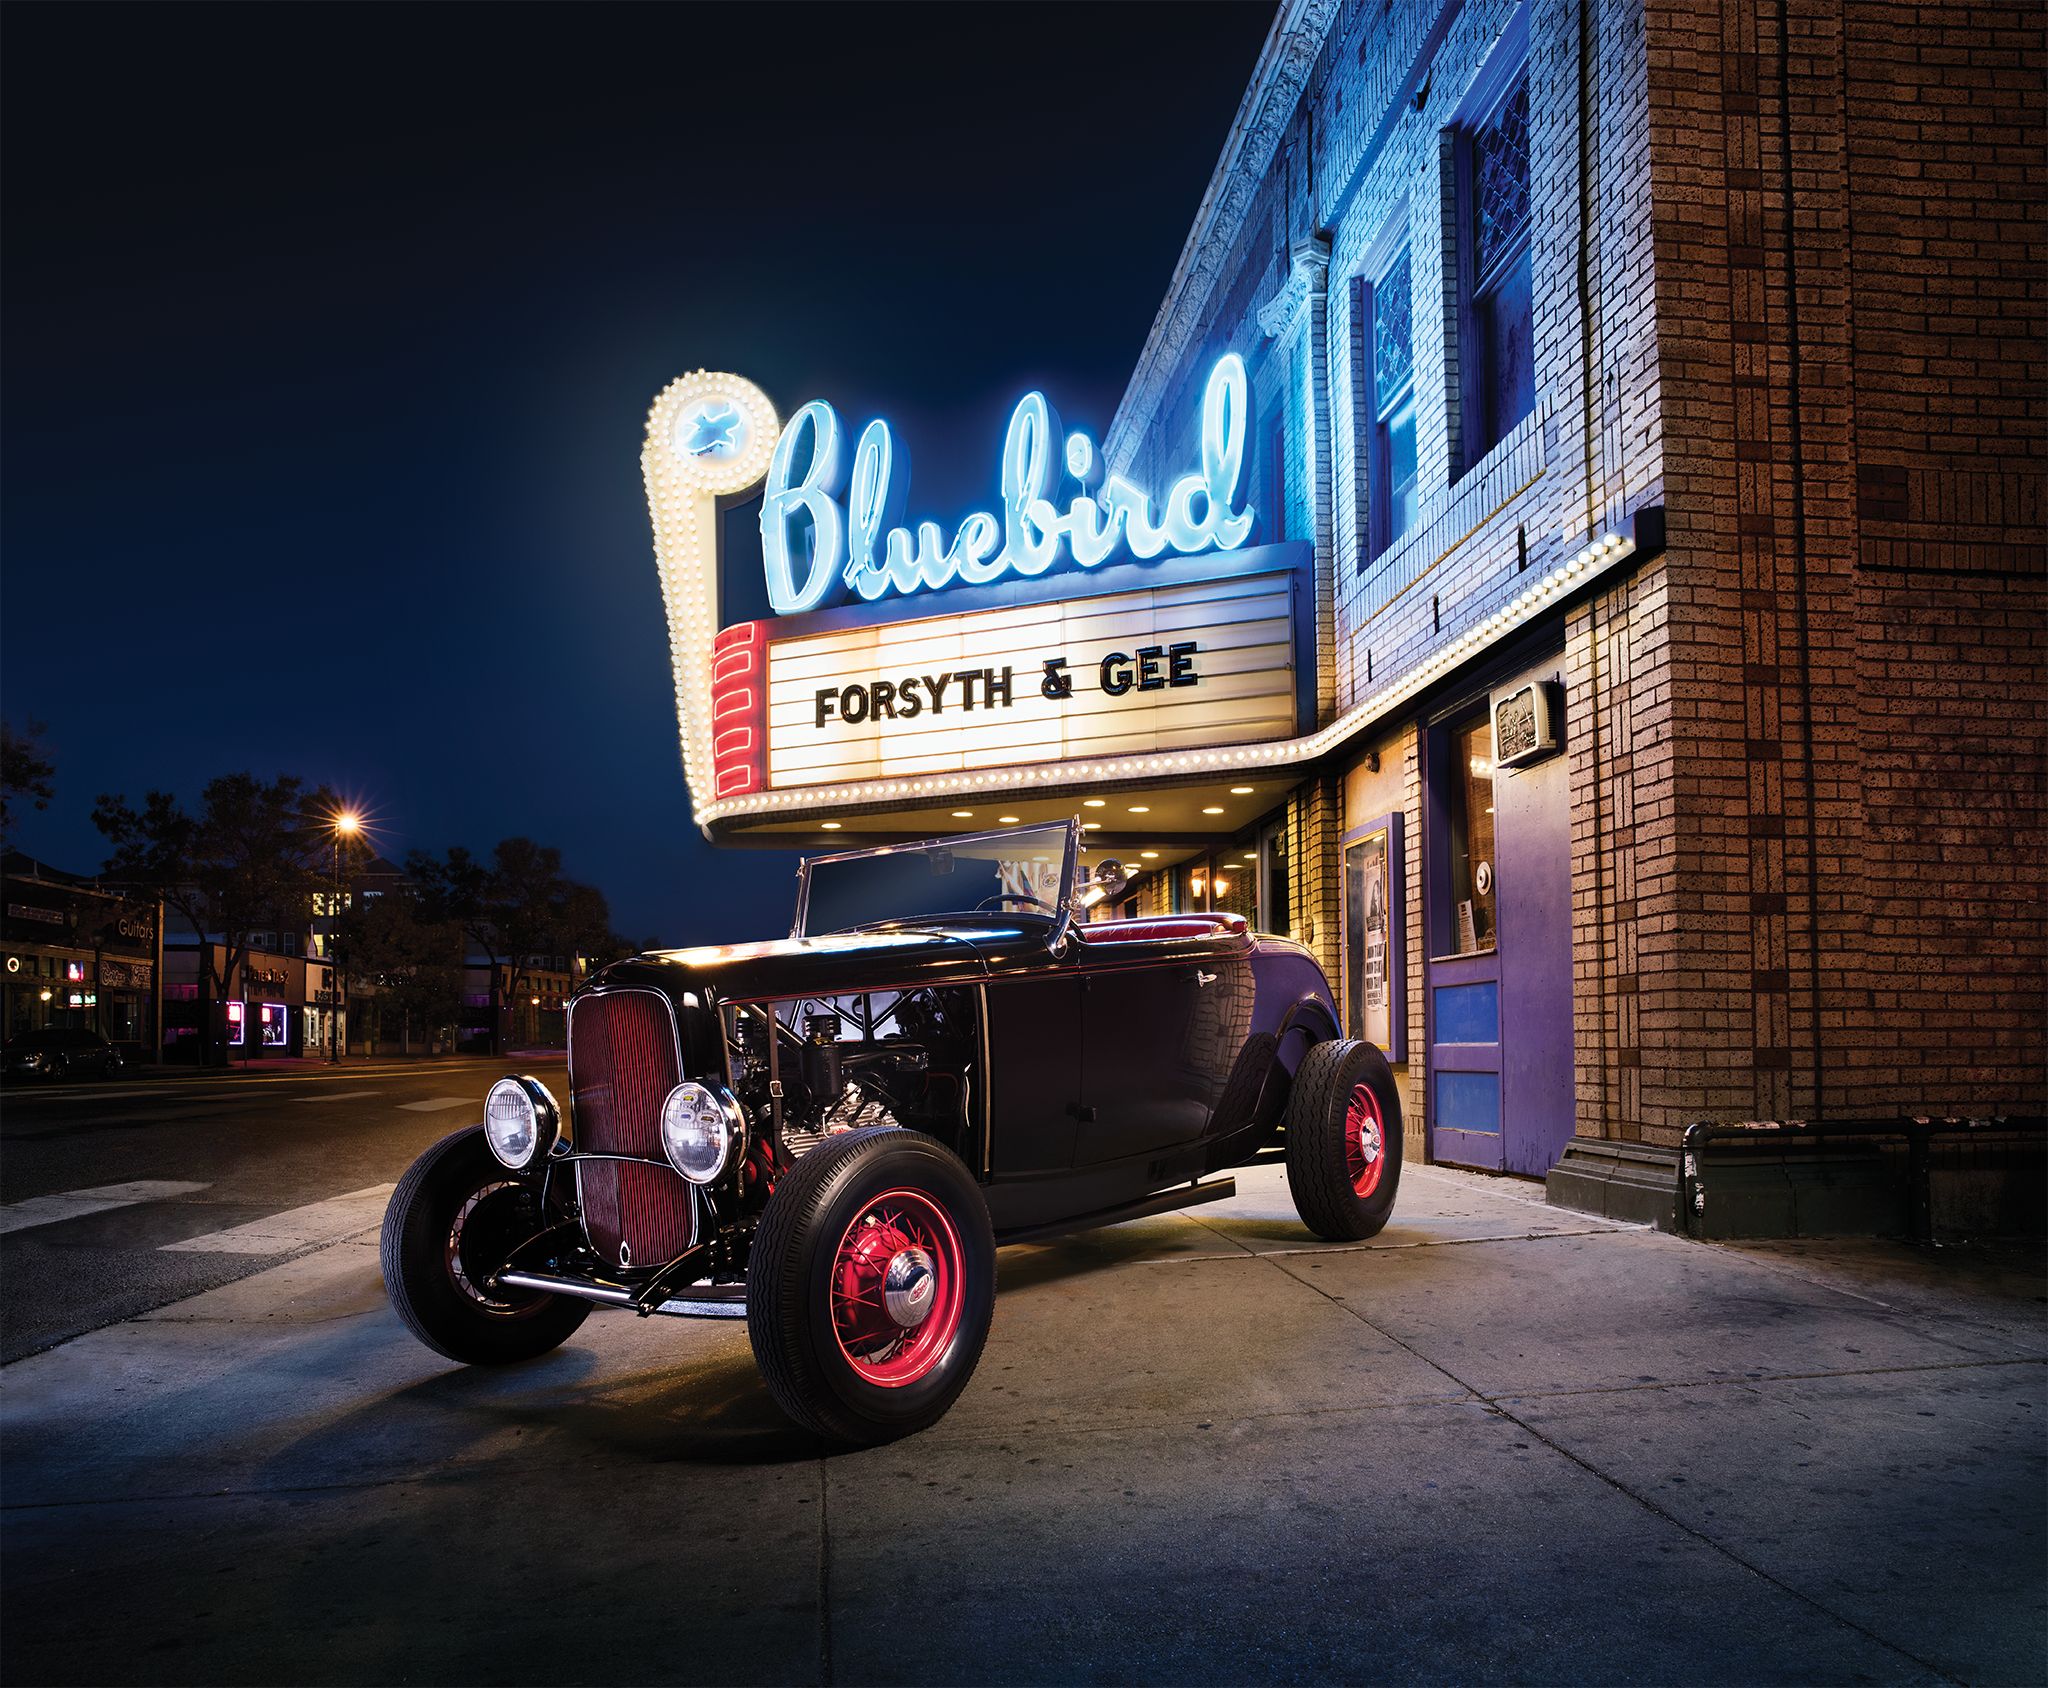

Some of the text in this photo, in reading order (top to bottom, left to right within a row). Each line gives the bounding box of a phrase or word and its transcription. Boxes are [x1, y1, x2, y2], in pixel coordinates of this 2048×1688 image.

[759, 352, 1256, 615] Bluebird
[815, 641, 1199, 728] FORSYTH & GEE
[118, 918, 154, 940] Guitars
